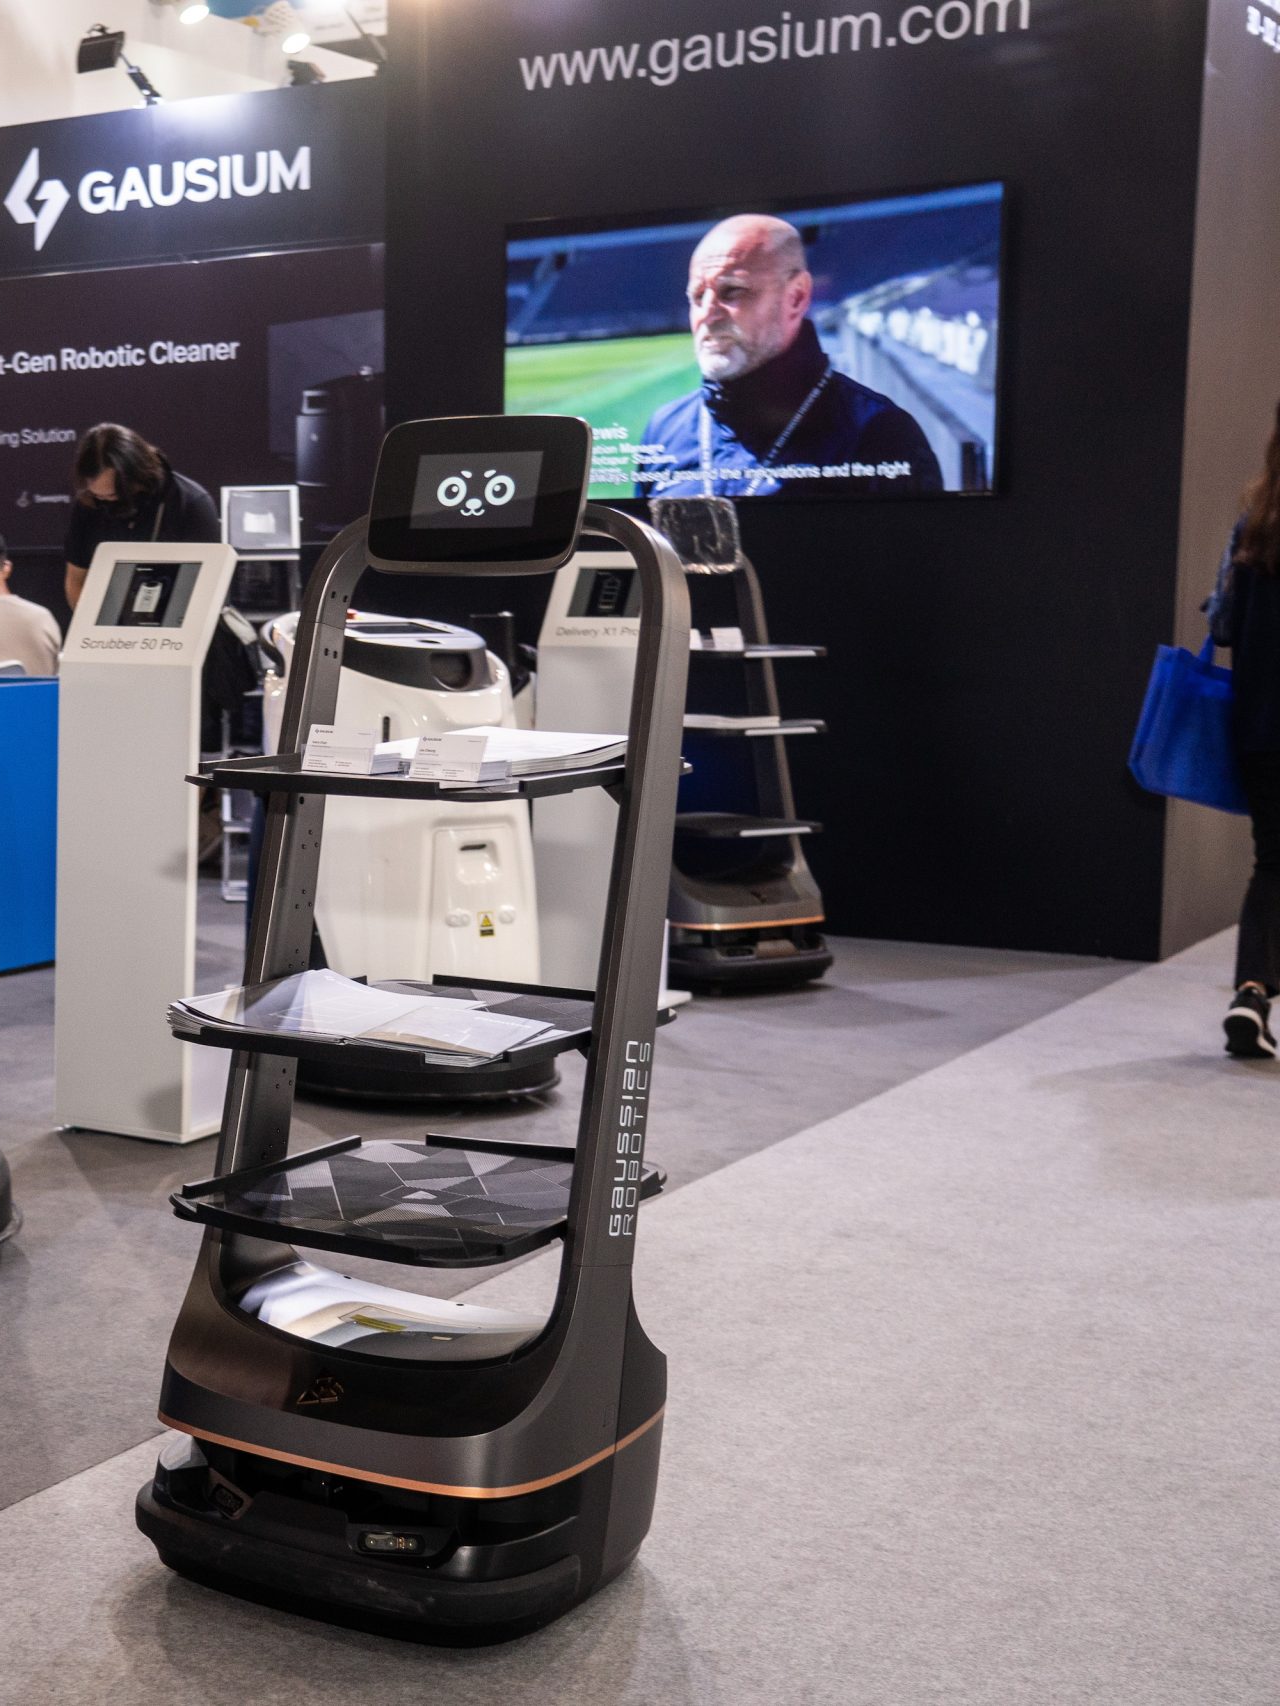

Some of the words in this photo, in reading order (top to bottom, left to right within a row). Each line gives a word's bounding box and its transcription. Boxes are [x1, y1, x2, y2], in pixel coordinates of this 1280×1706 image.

[518, 0, 1032, 90] www.gausium.com
[77, 145, 311, 215] GAUSIUM
[60, 344, 146, 371] Robotic
[148, 340, 241, 365] Cleaner
[20, 428, 77, 445] Solution
[592, 423, 628, 440] ewis
[630, 468, 671, 482] based
[719, 468, 742, 480] the
[822, 462, 851, 478] and
[851, 460, 876, 476] the
[876, 459, 912, 479] right
[555, 625, 599, 637] Delivery
[603, 627, 618, 637] X1
[620, 626, 639, 637] Pro
[80, 637, 137, 650] Scrubber
[140, 638, 158, 650] 50
[160, 639, 184, 651] Pro
[623, 1042, 651, 1236] ROBOTICS
